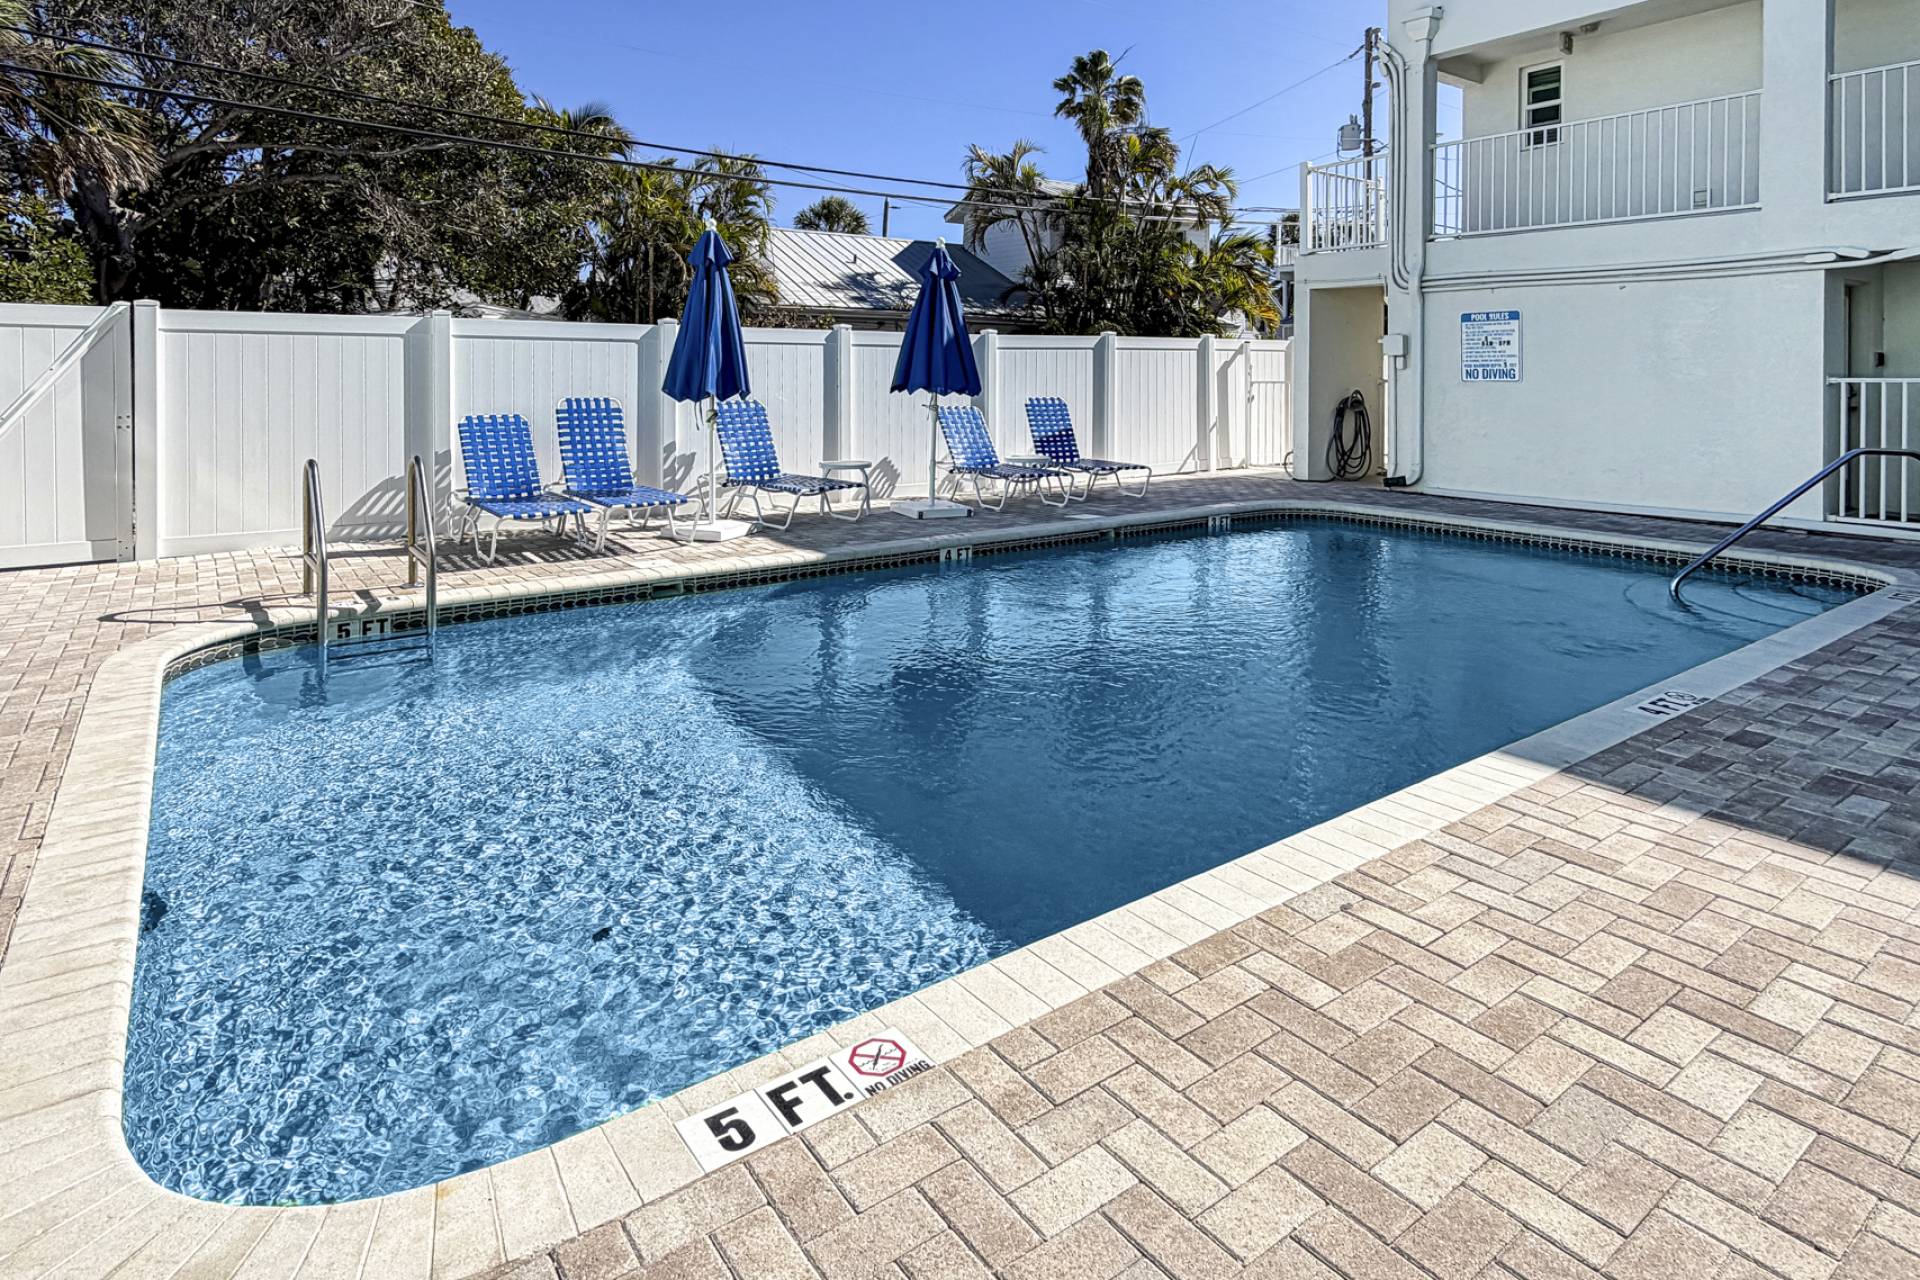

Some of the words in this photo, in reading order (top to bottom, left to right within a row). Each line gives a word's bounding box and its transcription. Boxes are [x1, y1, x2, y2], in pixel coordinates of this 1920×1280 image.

[1471, 313, 1487, 321] POOL
[1465, 368, 1480, 379] NO
[1482, 368, 1516, 379] DIVING
[945, 549, 952, 560] 4
[337, 622, 351, 639] 5
[362, 618, 389, 636] FT
[865, 1081, 887, 1097] NO
[886, 1059, 931, 1087] DIVING
[704, 1106, 756, 1152] 5
[766, 1065, 854, 1128] FT.
